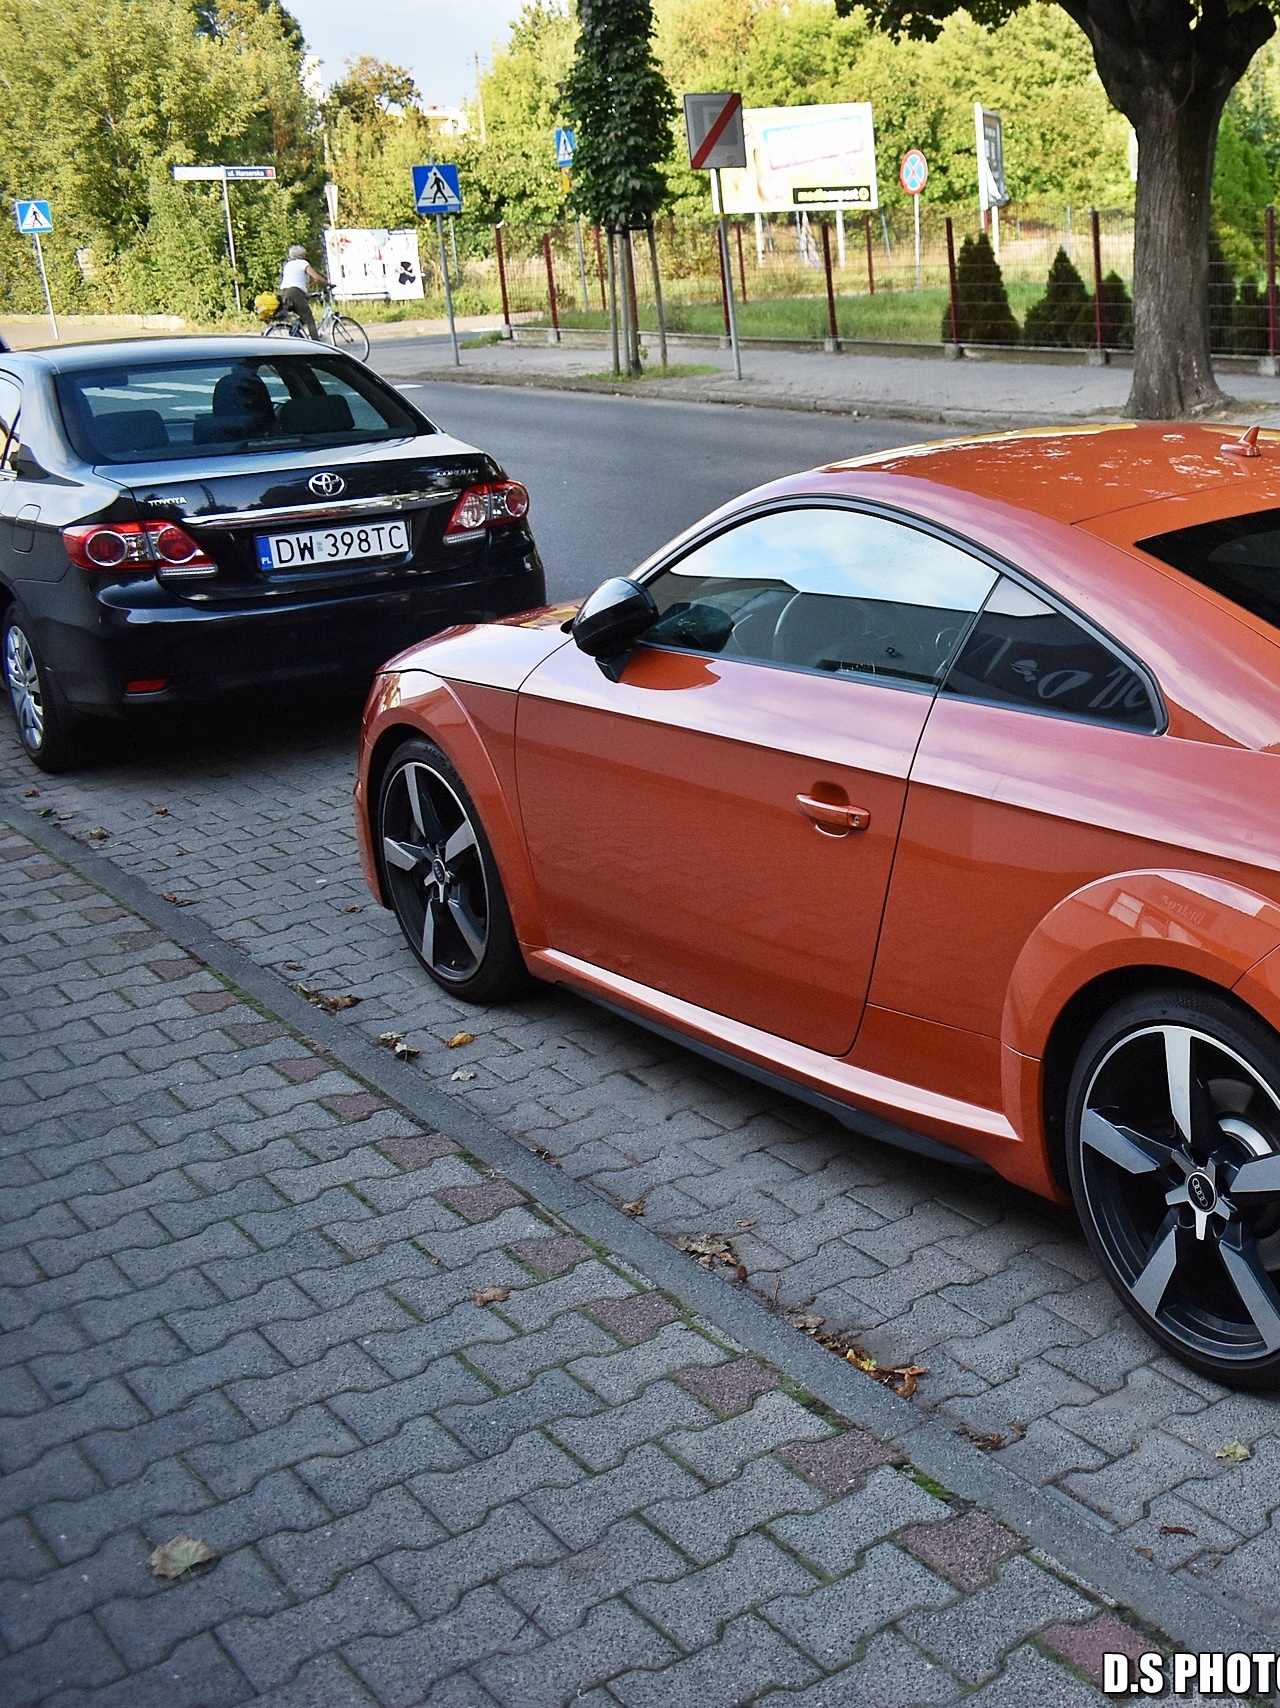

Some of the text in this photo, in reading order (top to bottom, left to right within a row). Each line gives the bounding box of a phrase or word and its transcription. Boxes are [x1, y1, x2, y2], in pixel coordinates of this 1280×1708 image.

[147, 496, 188, 507] TOYOTA
[275, 525, 404, 564] DW 398TC
[261, 557, 272, 565] PL
